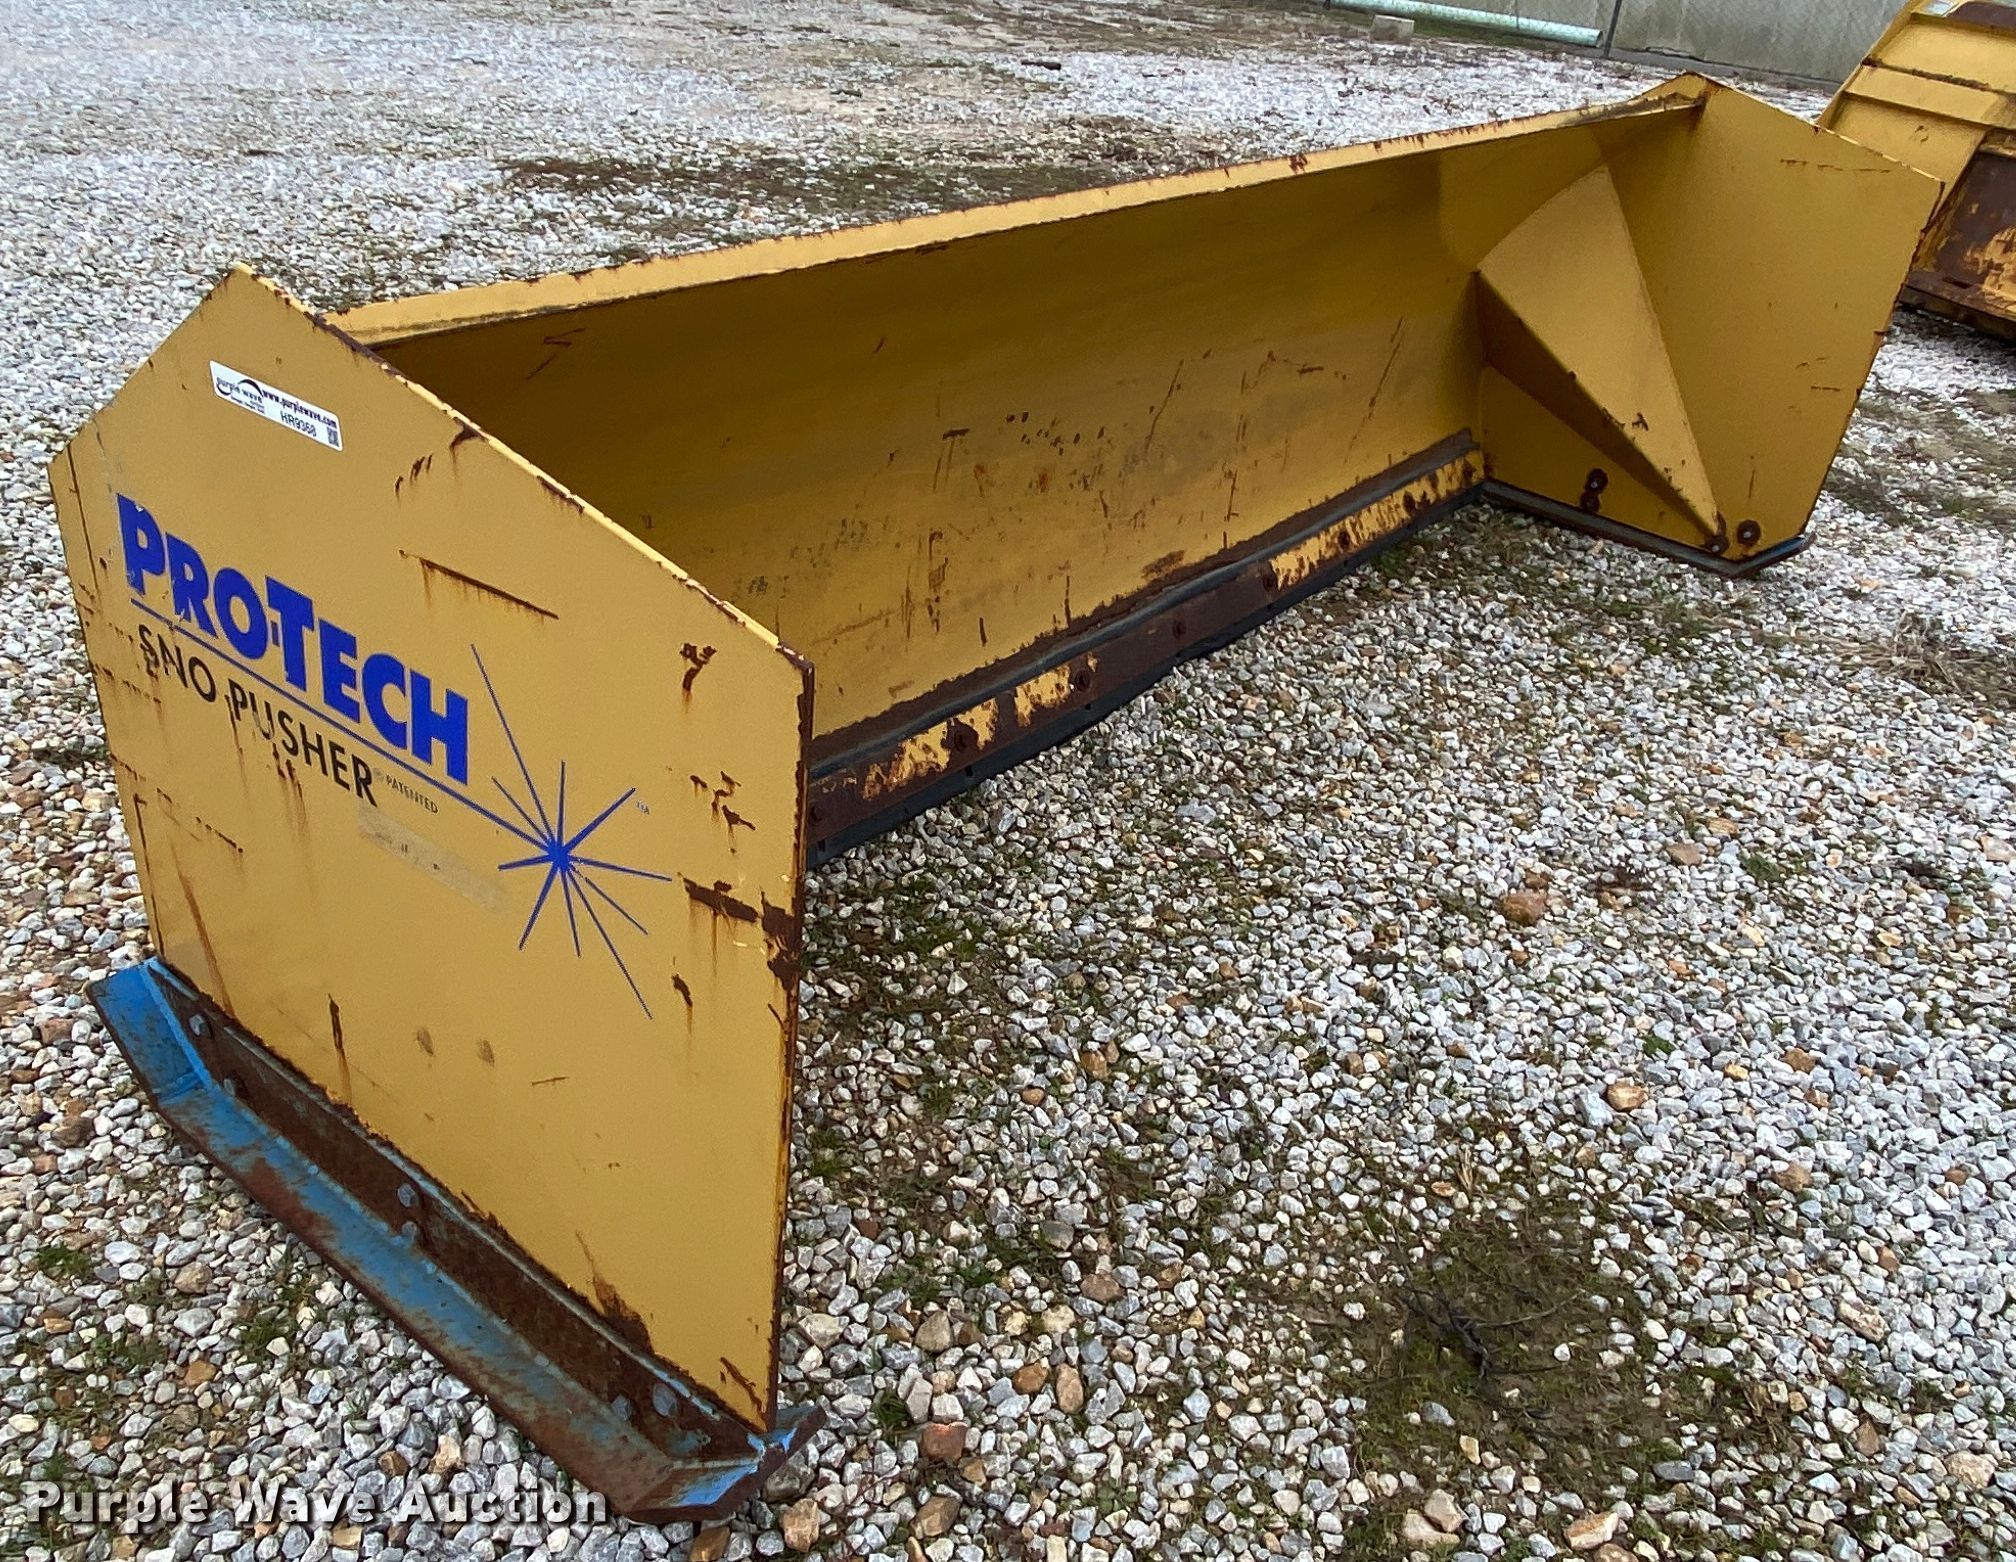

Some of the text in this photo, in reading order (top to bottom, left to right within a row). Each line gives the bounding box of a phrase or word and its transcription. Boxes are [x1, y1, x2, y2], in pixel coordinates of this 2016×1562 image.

[262, 390, 338, 429] www.purplewave.com
[138, 624, 377, 808] SNO PUSHER
[385, 774, 440, 814] PATENTED
